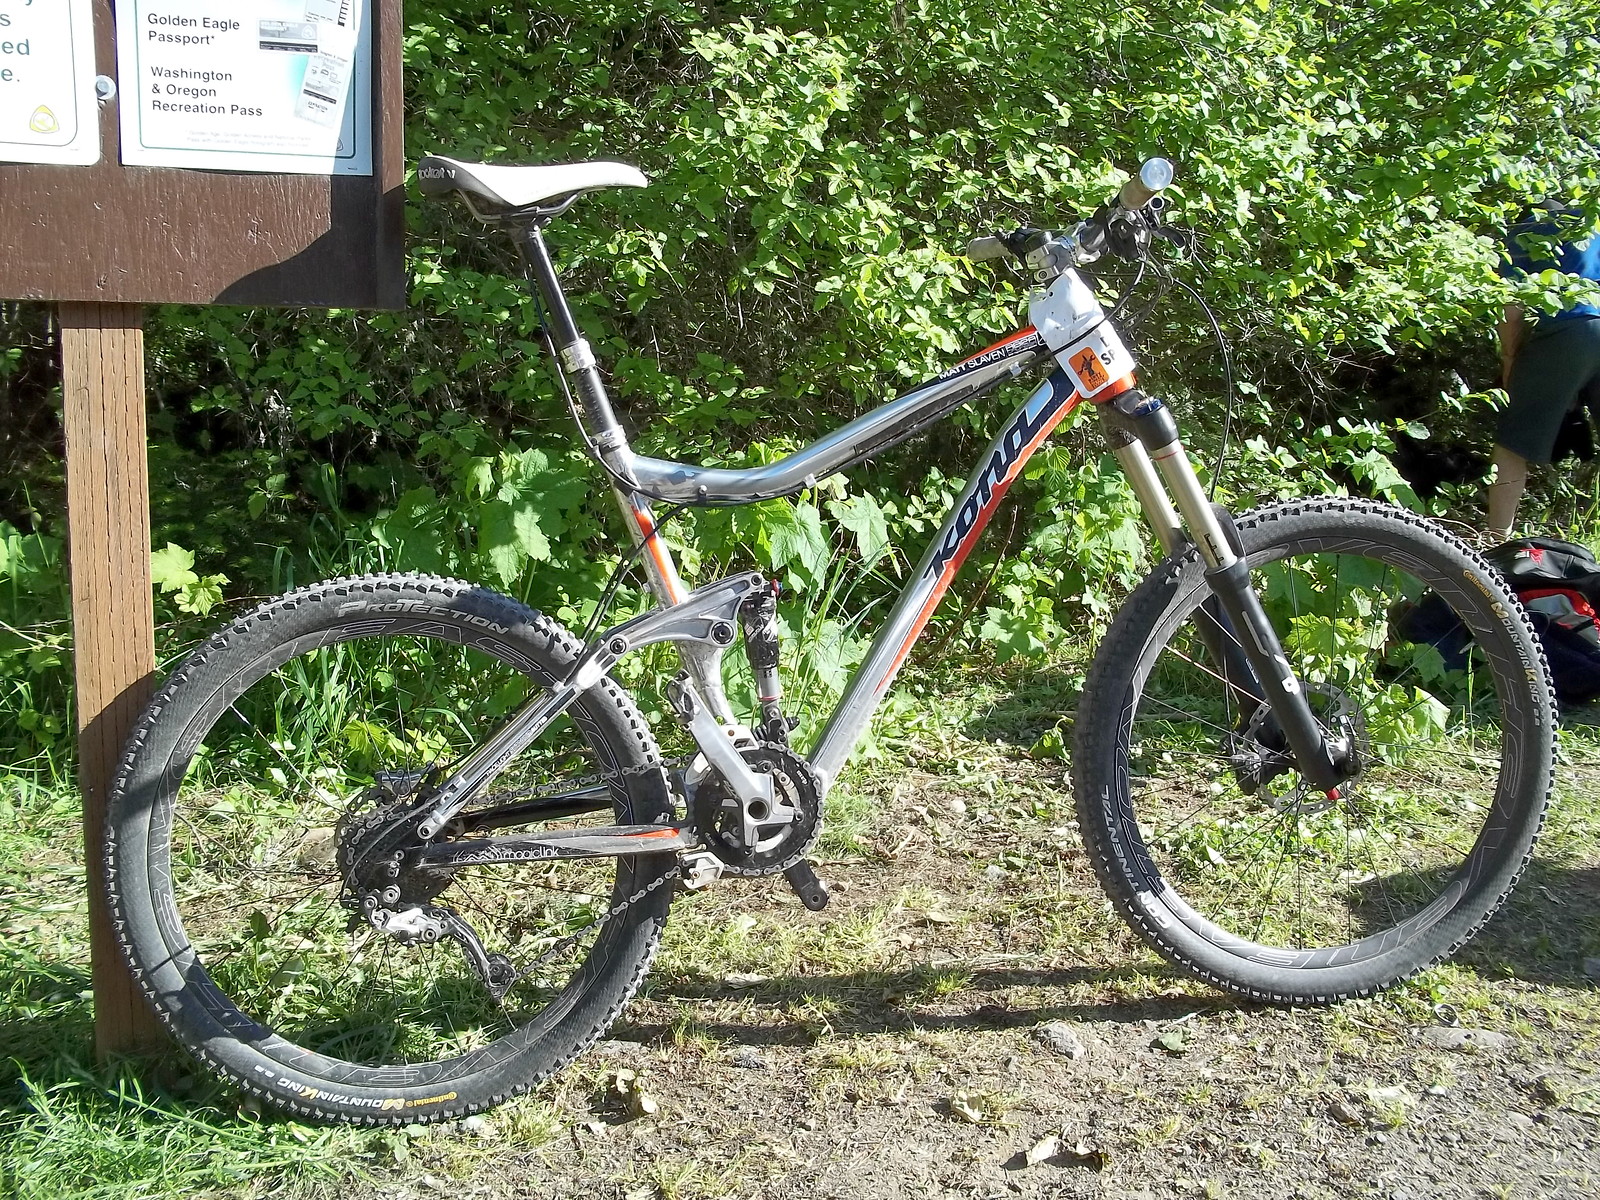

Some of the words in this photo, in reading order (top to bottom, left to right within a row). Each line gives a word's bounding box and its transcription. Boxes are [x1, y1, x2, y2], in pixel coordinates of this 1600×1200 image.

[147, 13, 197, 27] Golden
[202, 17, 240, 32] Eagle
[2, 38, 30, 55] ed
[151, 66, 232, 83] Washington
[152, 83, 161, 94] &
[166, 84, 217, 99] Oregon
[152, 100, 225, 114] Recreation
[231, 104, 263, 117] Pass
[939, 364, 967, 380] MATT
[968, 347, 1006, 369] SLAVEN
